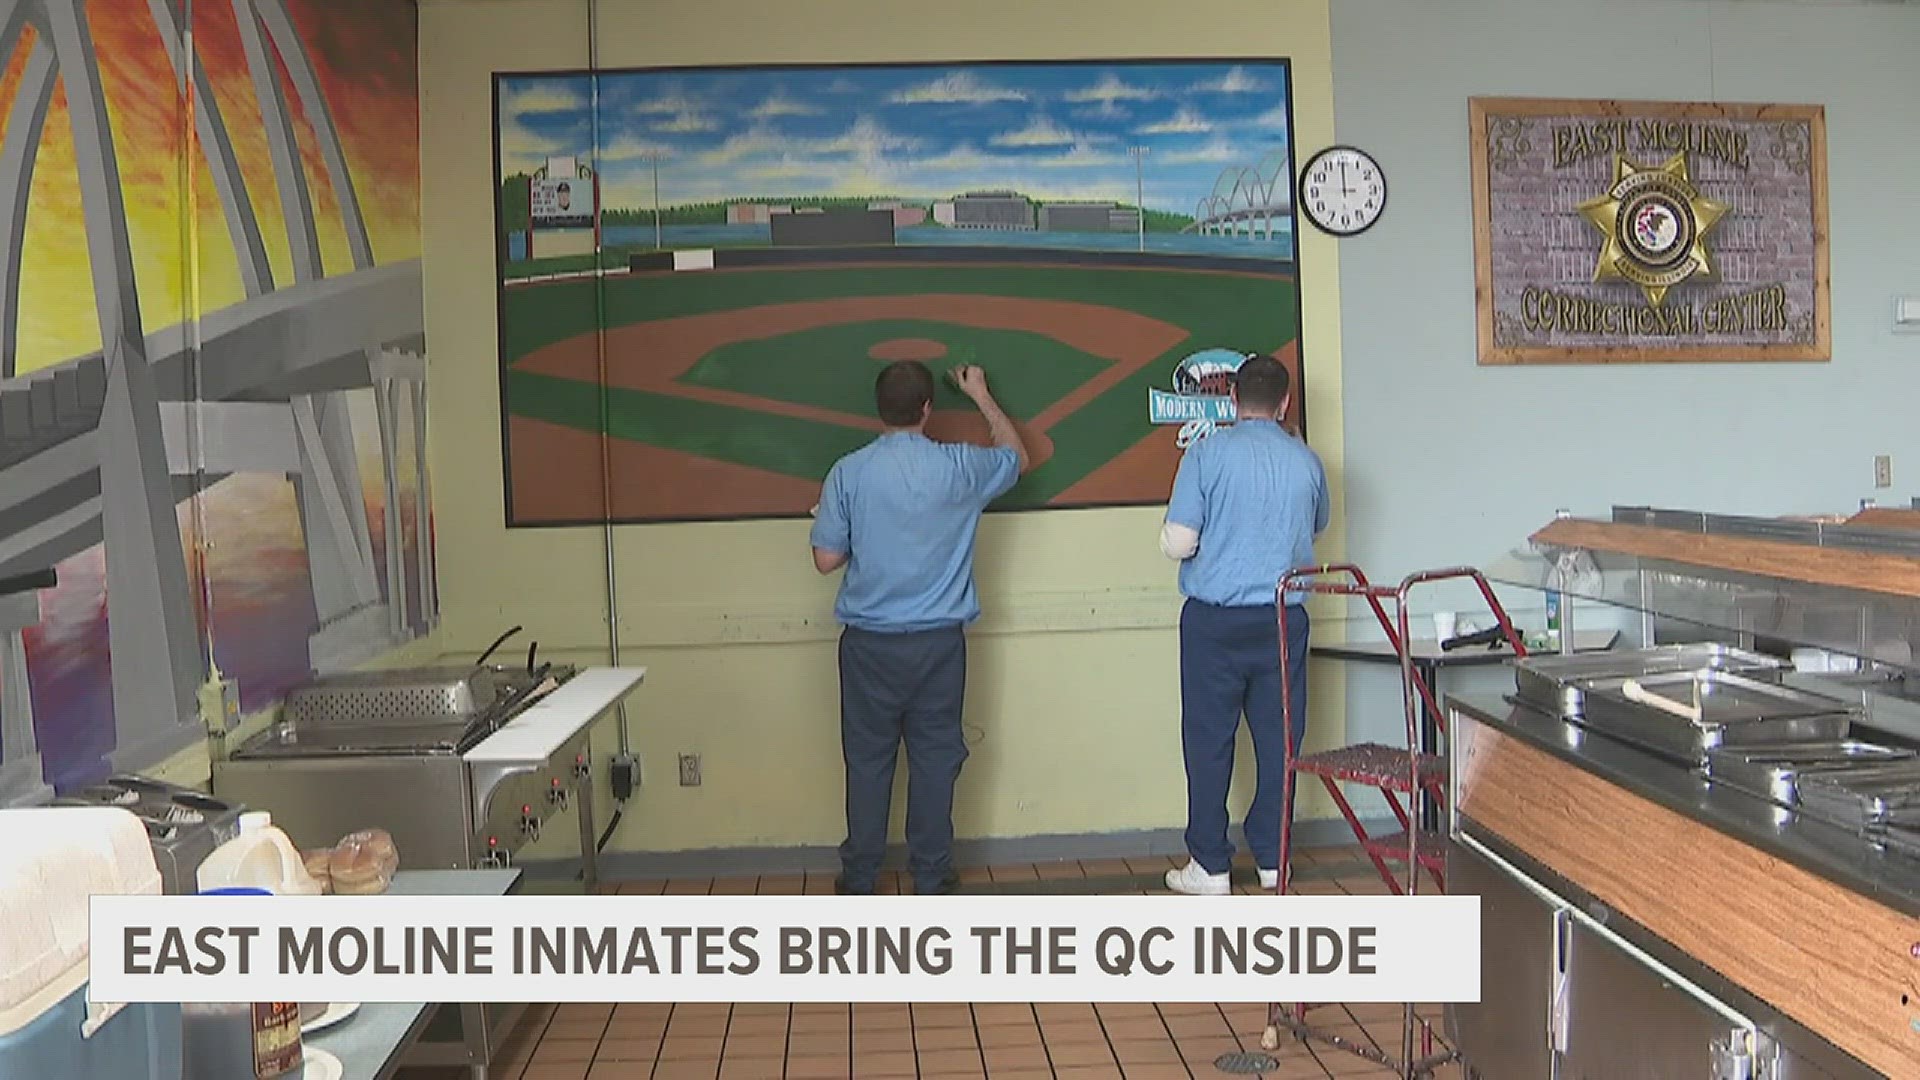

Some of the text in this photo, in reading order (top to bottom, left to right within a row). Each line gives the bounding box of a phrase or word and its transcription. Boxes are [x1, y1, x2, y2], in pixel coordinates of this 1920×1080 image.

[1551, 118, 1749, 170] EAST MOLINE
[1521, 284, 1787, 336] CORRECTIONAL CENTER
[1155, 395, 1238, 418] MODERN WO
